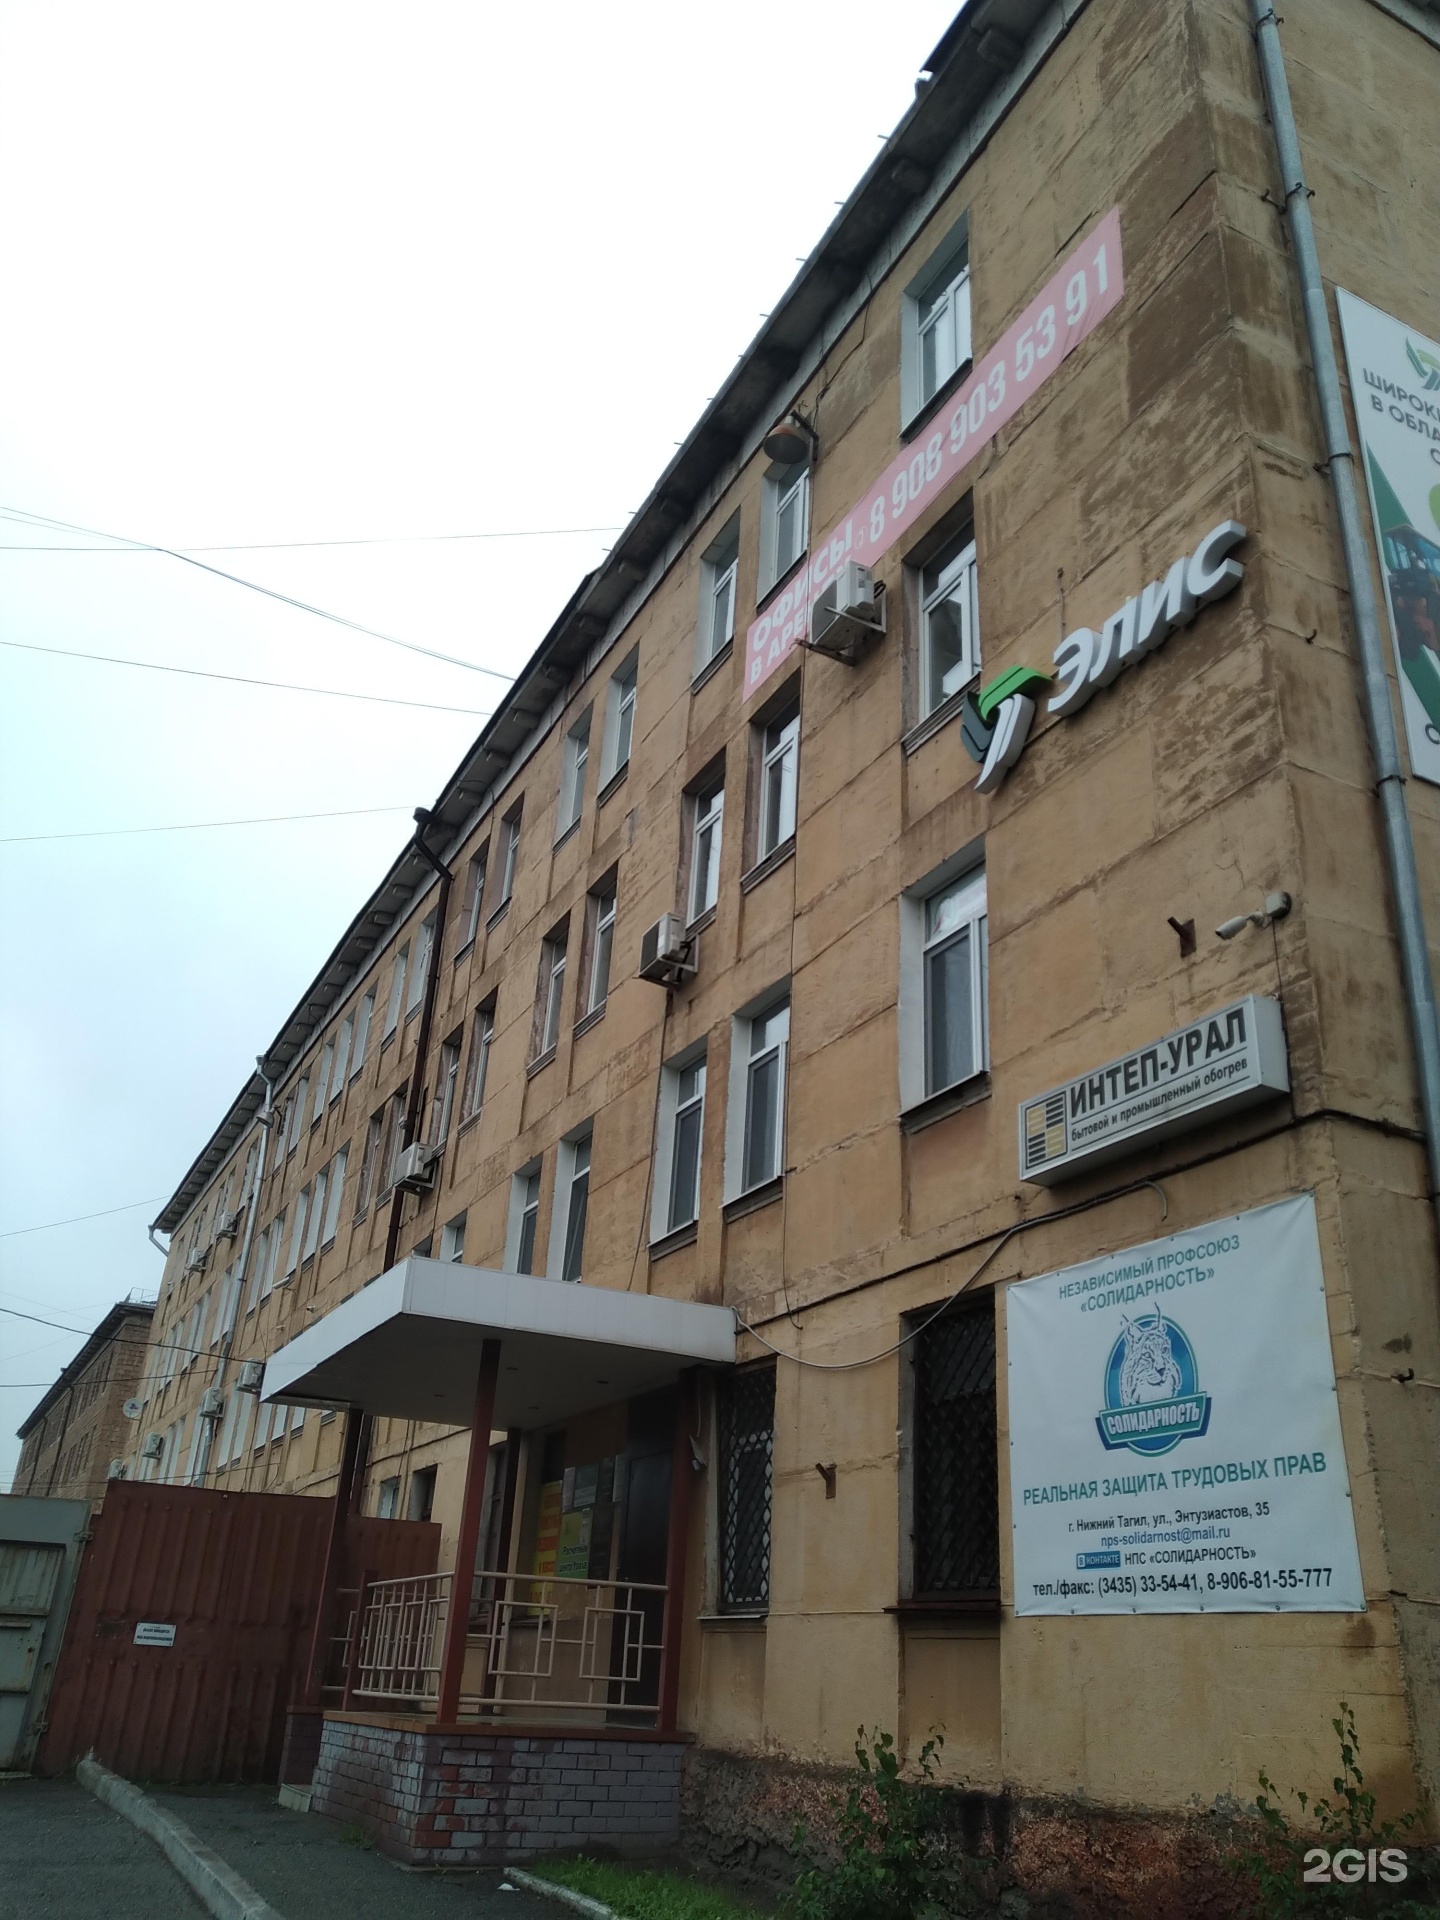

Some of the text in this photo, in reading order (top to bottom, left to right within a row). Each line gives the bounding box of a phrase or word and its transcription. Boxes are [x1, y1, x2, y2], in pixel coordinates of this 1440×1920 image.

[1363, 368, 1440, 424] ШИРОК
[1371, 393, 1384, 412] В
[753, 519, 852, 652] ОФИСЫ
[869, 495, 885, 543] 8
[892, 430, 943, 518] 908
[950, 358, 1006, 454] 903
[1015, 303, 1056, 383] 53
[1048, 519, 1246, 716] ЭЛИС
[750, 656, 762, 684] В
[1071, 1007, 1247, 1118] ИНТЕП-УРАЛ
[1071, 1057, 1248, 1142] бытовой и промышленный обогрев
[1059, 1235, 1240, 1300] НЕЗАВИСИМЫЙ ПРОФСОЮЗ
[1080, 1266, 1215, 1313] «СОЛИДАРНОСТЬ»
[1106, 1401, 1200, 1434] СОЛИДАРНОСТЬ
[1023, 1452, 1327, 1506] РЕАЛЬНАЯ ЗАЩИТА ТРУДОВЫХ ПРАВ
[1068, 1501, 1270, 1533] г. Нижний Тагил, ул., Энтузиастов, 35
[1100, 1526, 1231, 1548] nps-solidarnost@mail.ru
[1124, 1552, 1147, 1566] НПС
[1149, 1546, 1257, 1565] «СОЛИДАРНОСТЬ»
[1033, 1568, 1333, 1599] тел./факс: (3435) 33-54-41, 8-906-81-55-777
